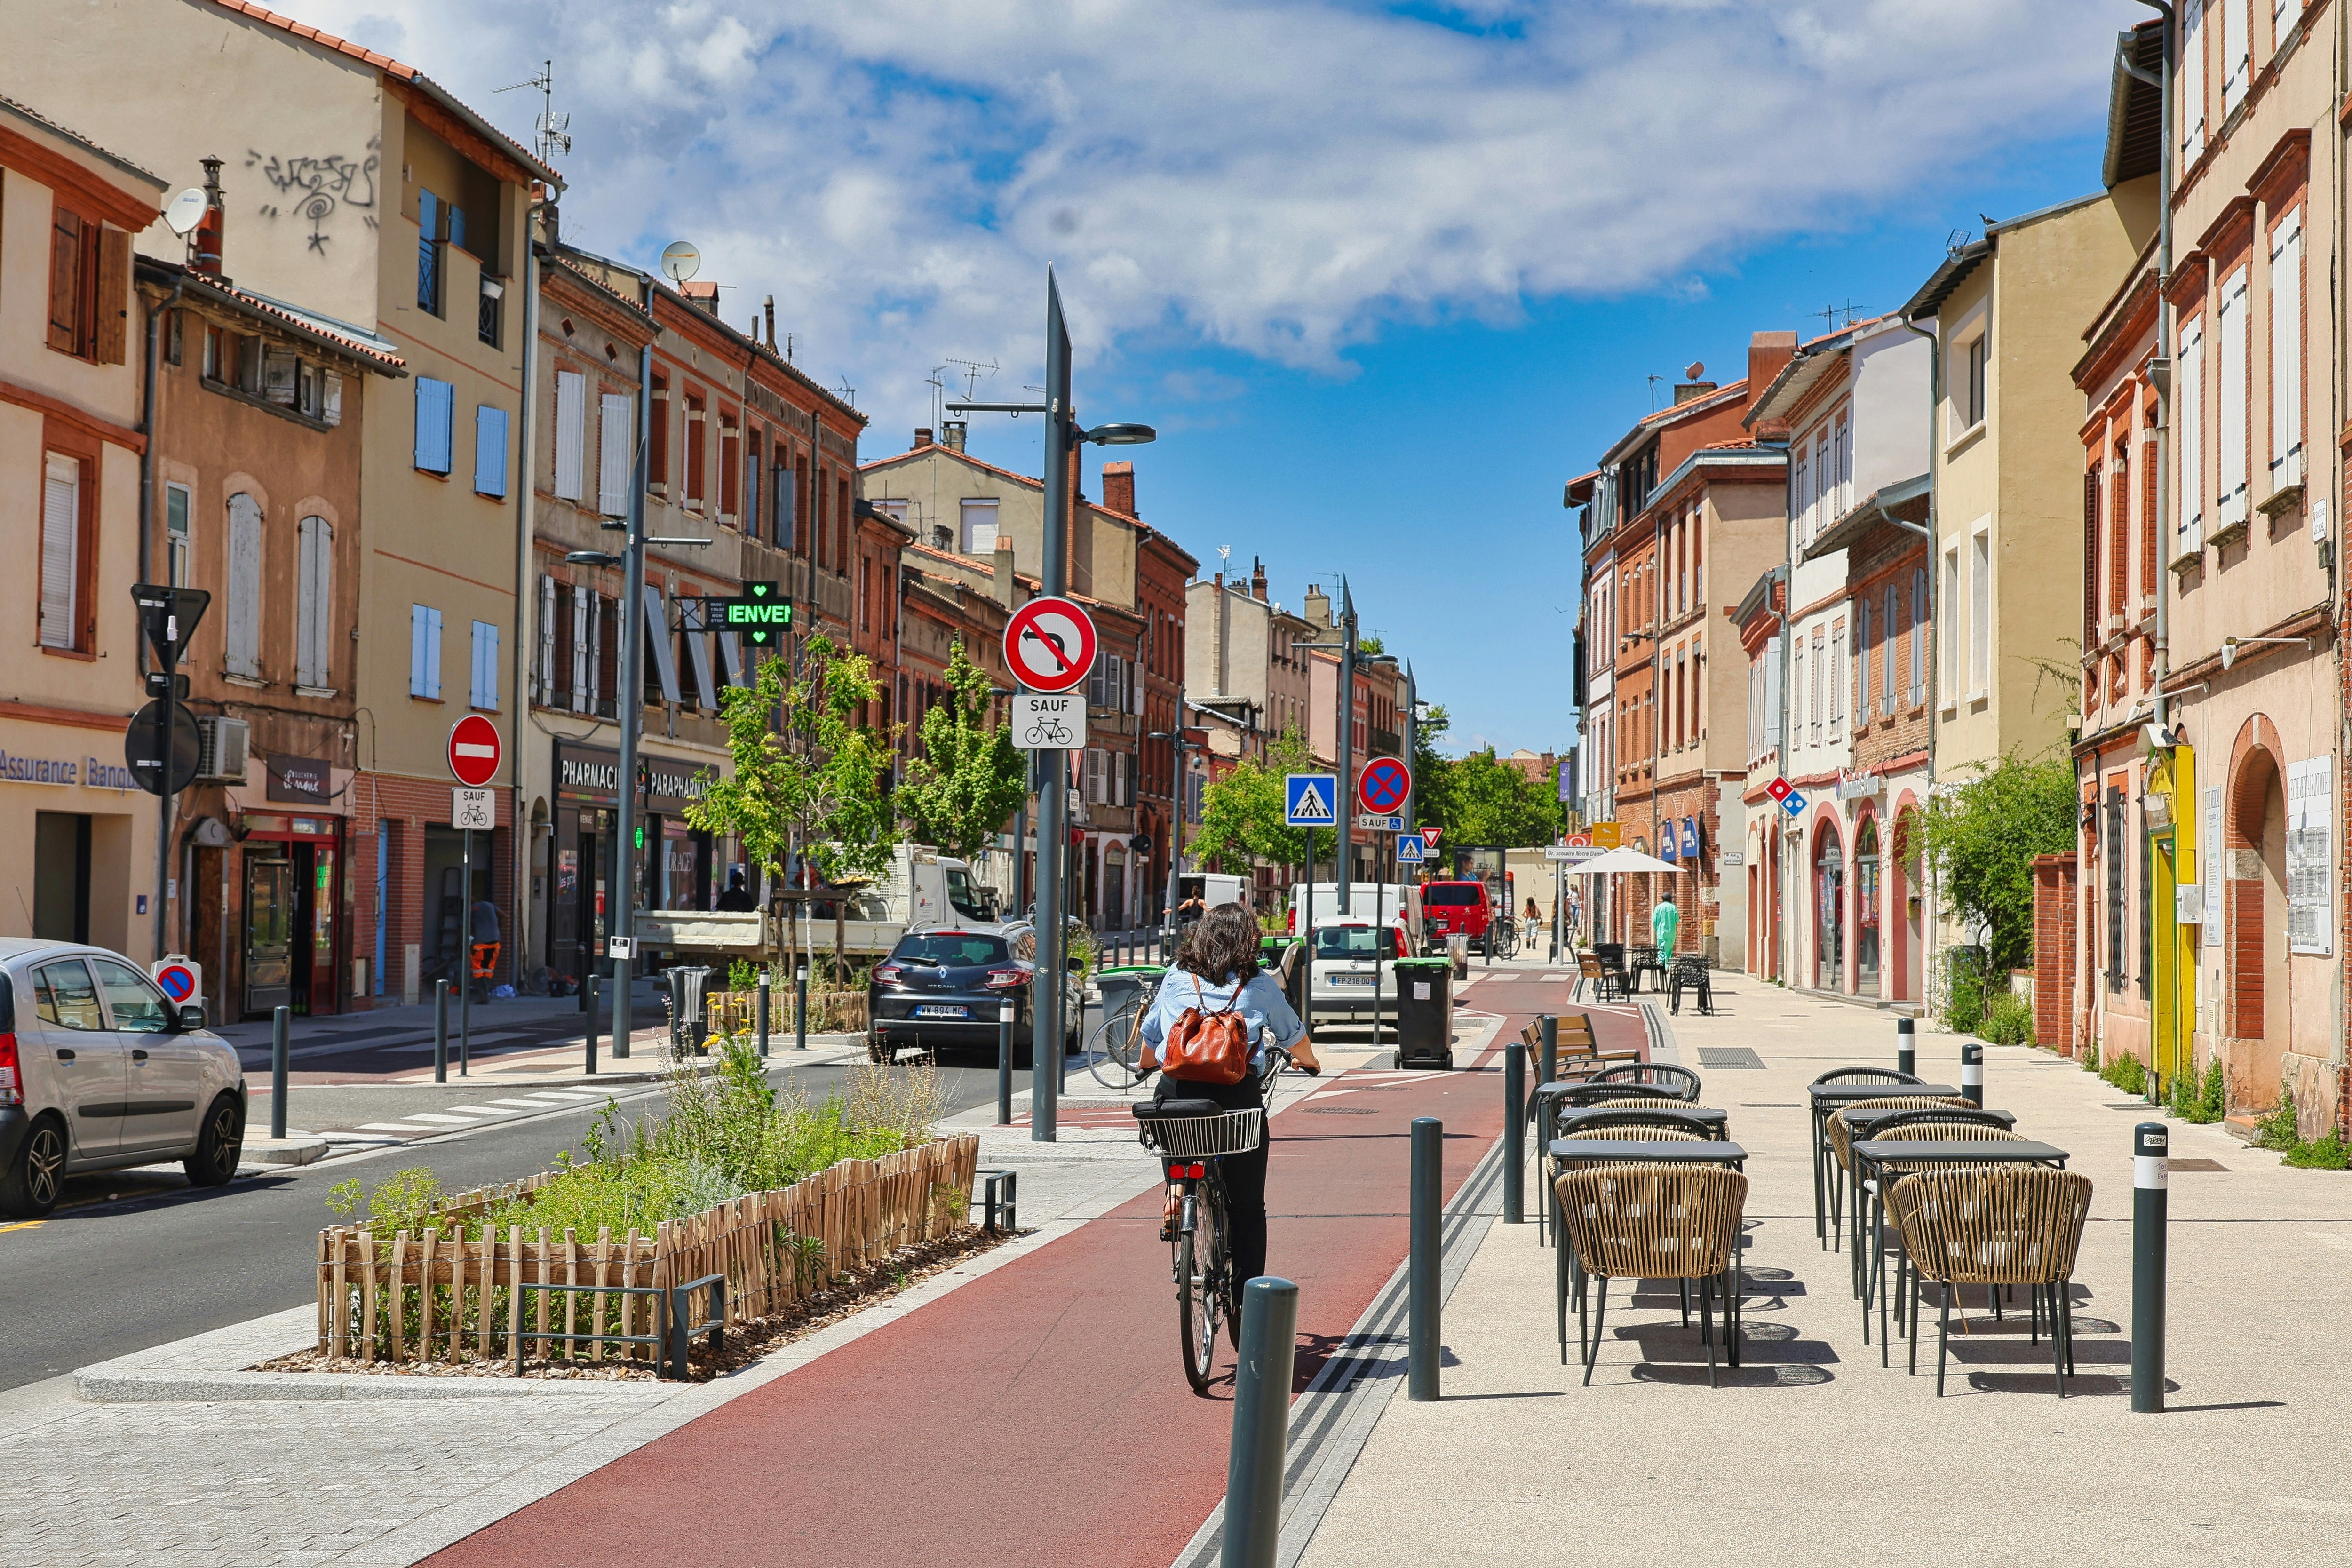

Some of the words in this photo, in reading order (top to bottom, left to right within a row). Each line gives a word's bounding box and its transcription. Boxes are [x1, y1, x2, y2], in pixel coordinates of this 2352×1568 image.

[1030, 700, 1068, 712] SAUF
[0, 749, 76, 784] Assurance
[562, 760, 620, 790] PHARMACI
[463, 791, 485, 801] SAUF
[1362, 819, 1387, 827] SAUF
[663, 851, 691, 871] HORACE
[922, 1006, 962, 1015] WW-894-MG
